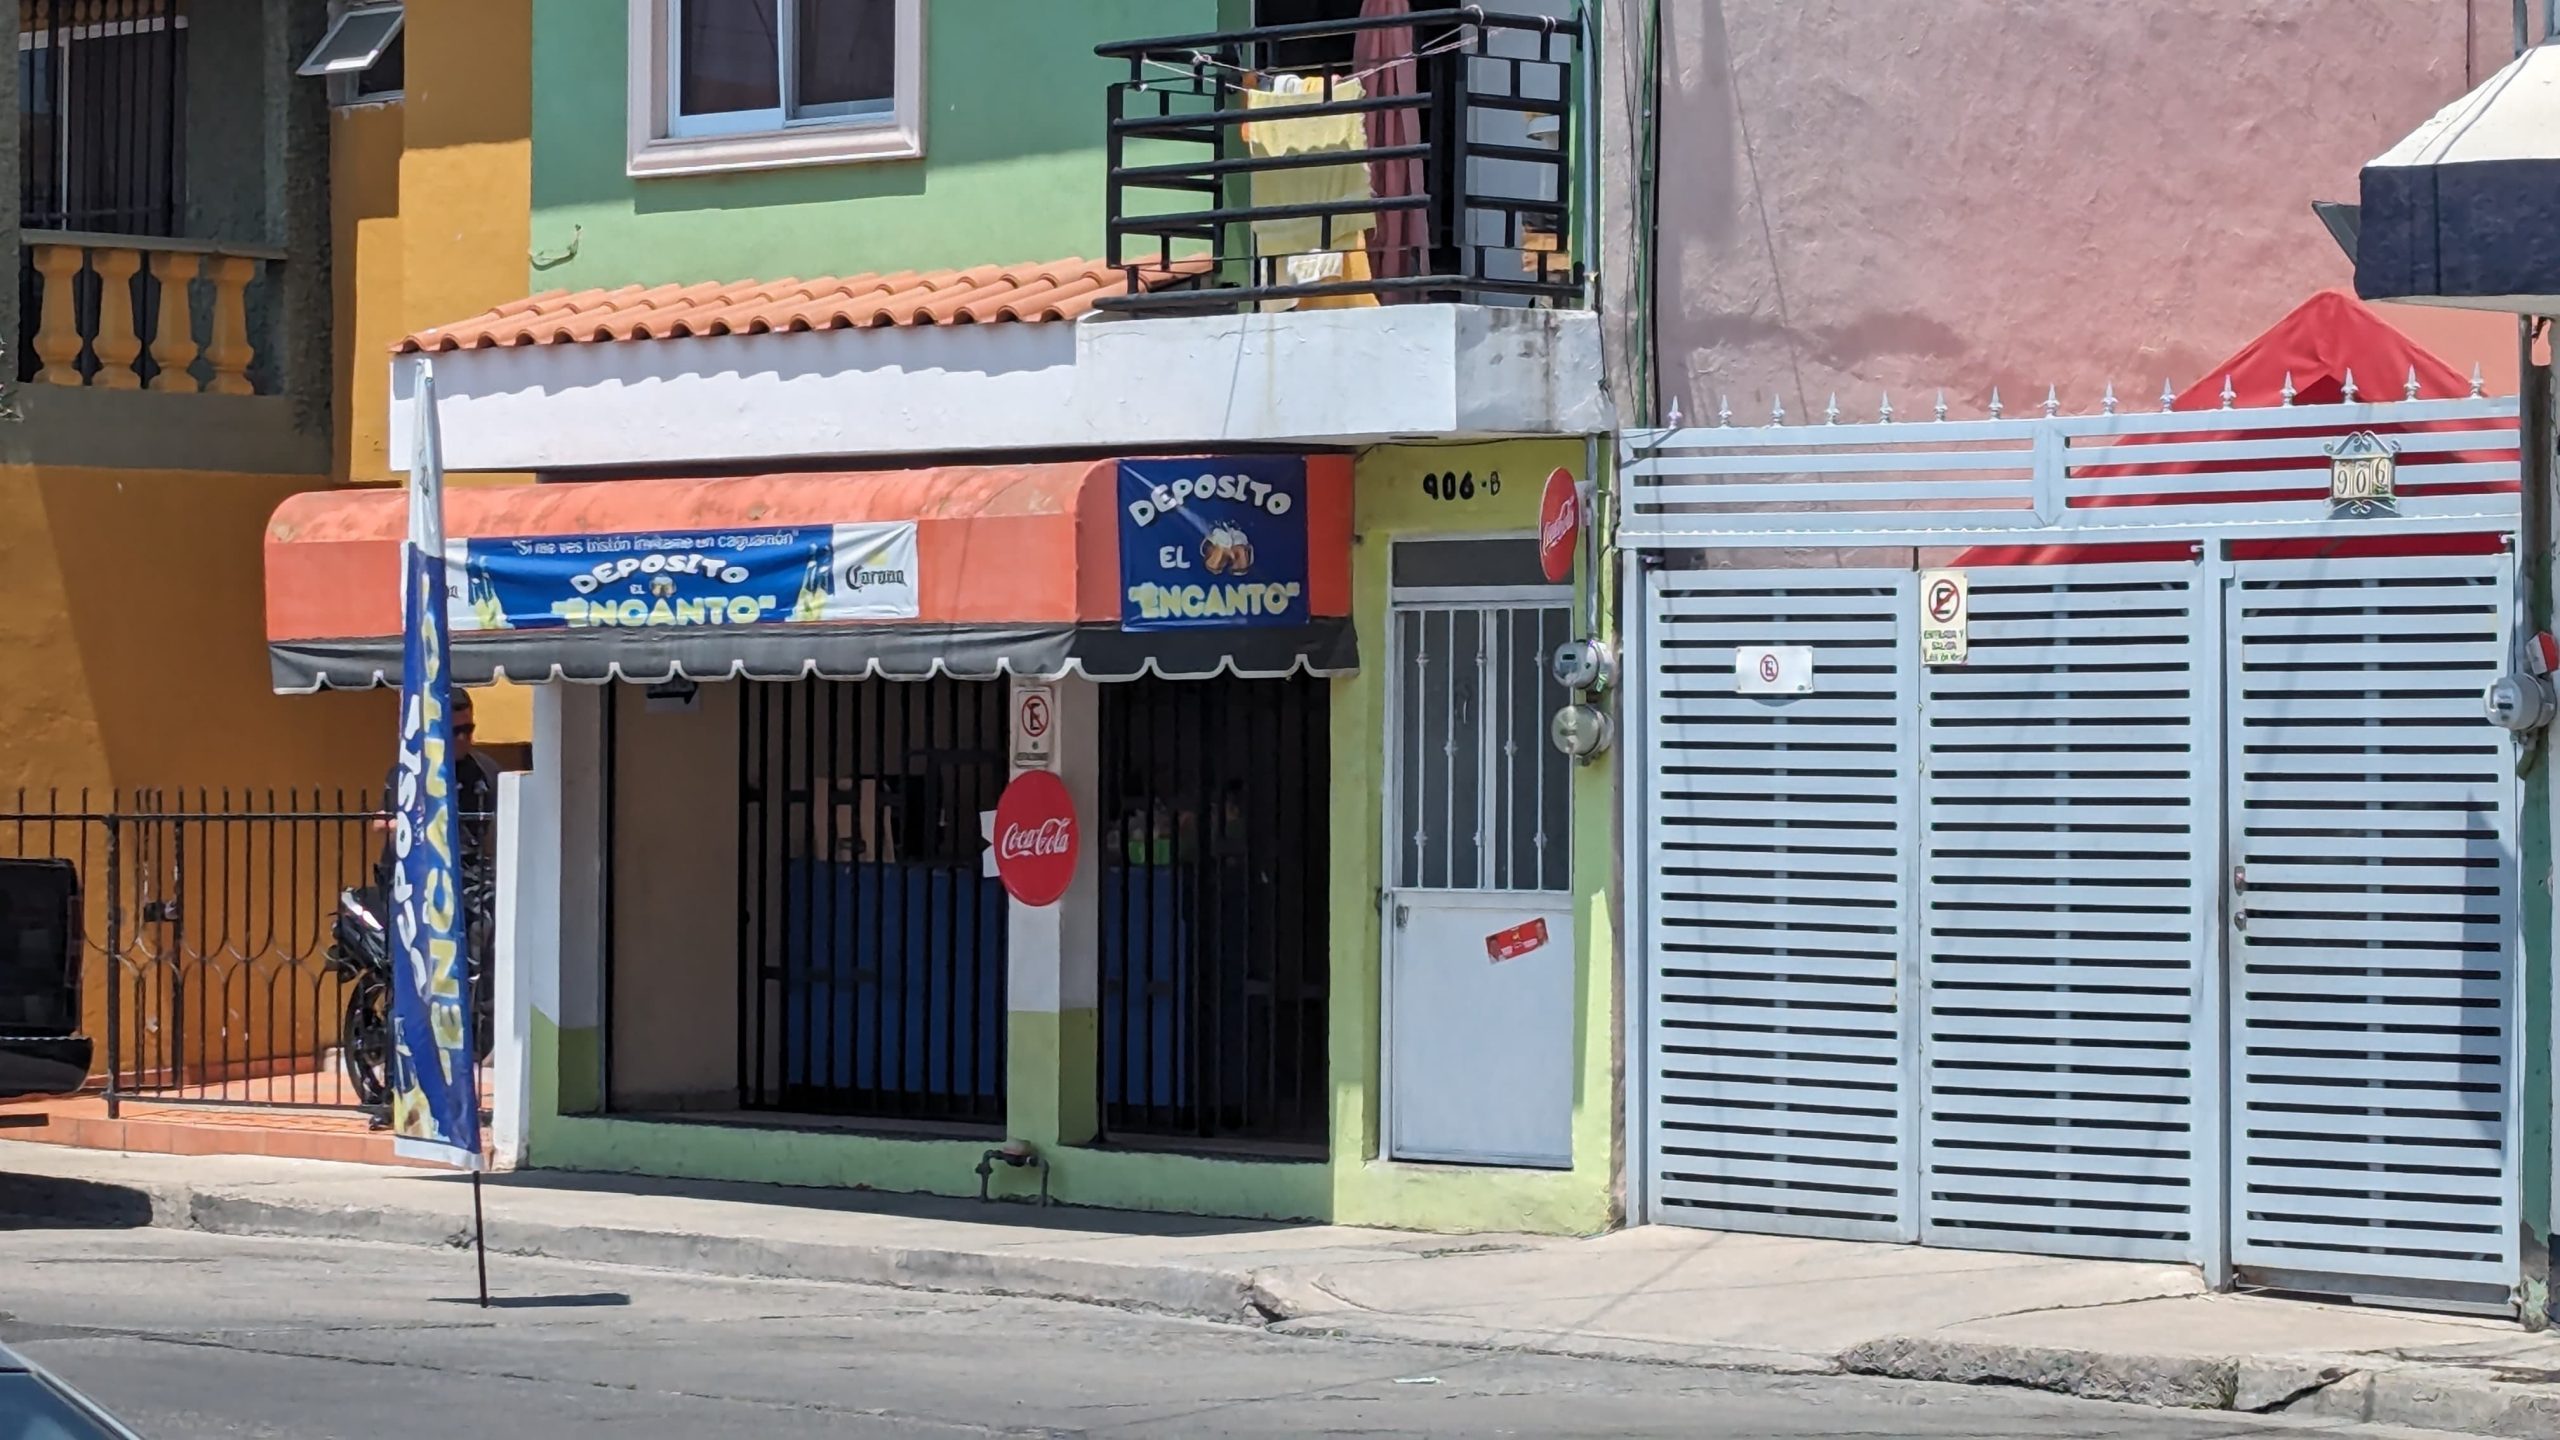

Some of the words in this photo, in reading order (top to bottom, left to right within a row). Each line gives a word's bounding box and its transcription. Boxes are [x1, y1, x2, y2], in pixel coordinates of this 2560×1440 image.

[2337, 458, 2386, 495] 906
[1128, 474, 1292, 527] DEPOSITO
[1159, 545, 1191, 569] EL
[570, 553, 750, 594] DEPOSITO
[629, 584, 646, 595] EL
[845, 564, 908, 591] Corona
